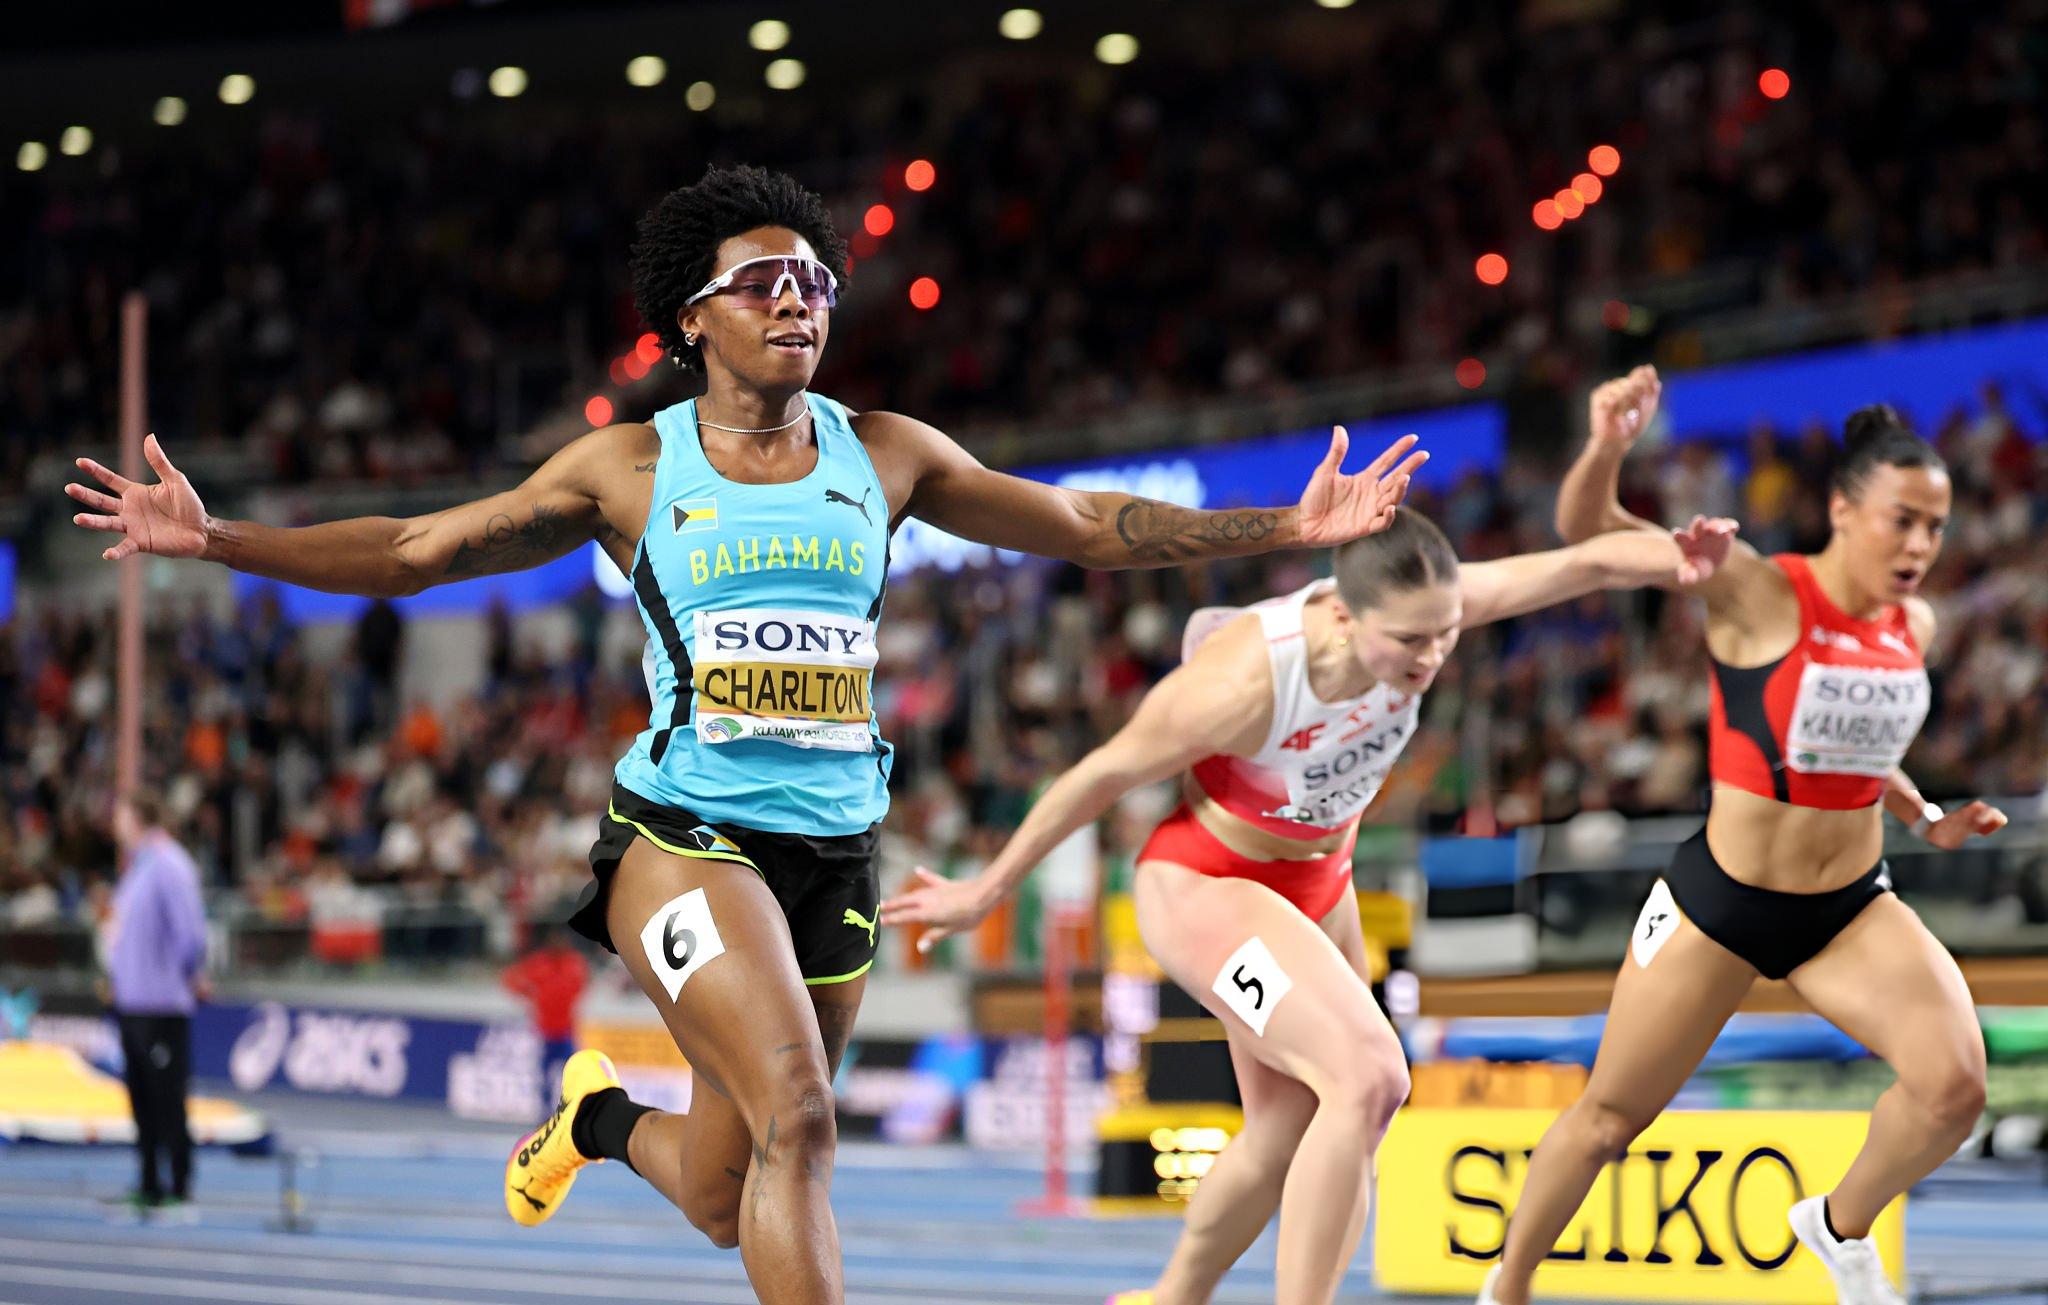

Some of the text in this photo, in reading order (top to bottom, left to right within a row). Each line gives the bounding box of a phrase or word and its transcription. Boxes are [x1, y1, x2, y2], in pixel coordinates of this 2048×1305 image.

[690, 536, 865, 586] BAHAMAS
[714, 621, 862, 654] SONY
[704, 668, 864, 714] CHARLTON
[1816, 674, 1921, 705] SONY
[1304, 726, 1403, 790] SONY
[662, 910, 697, 971] 6
[1232, 964, 1264, 1010] 5
